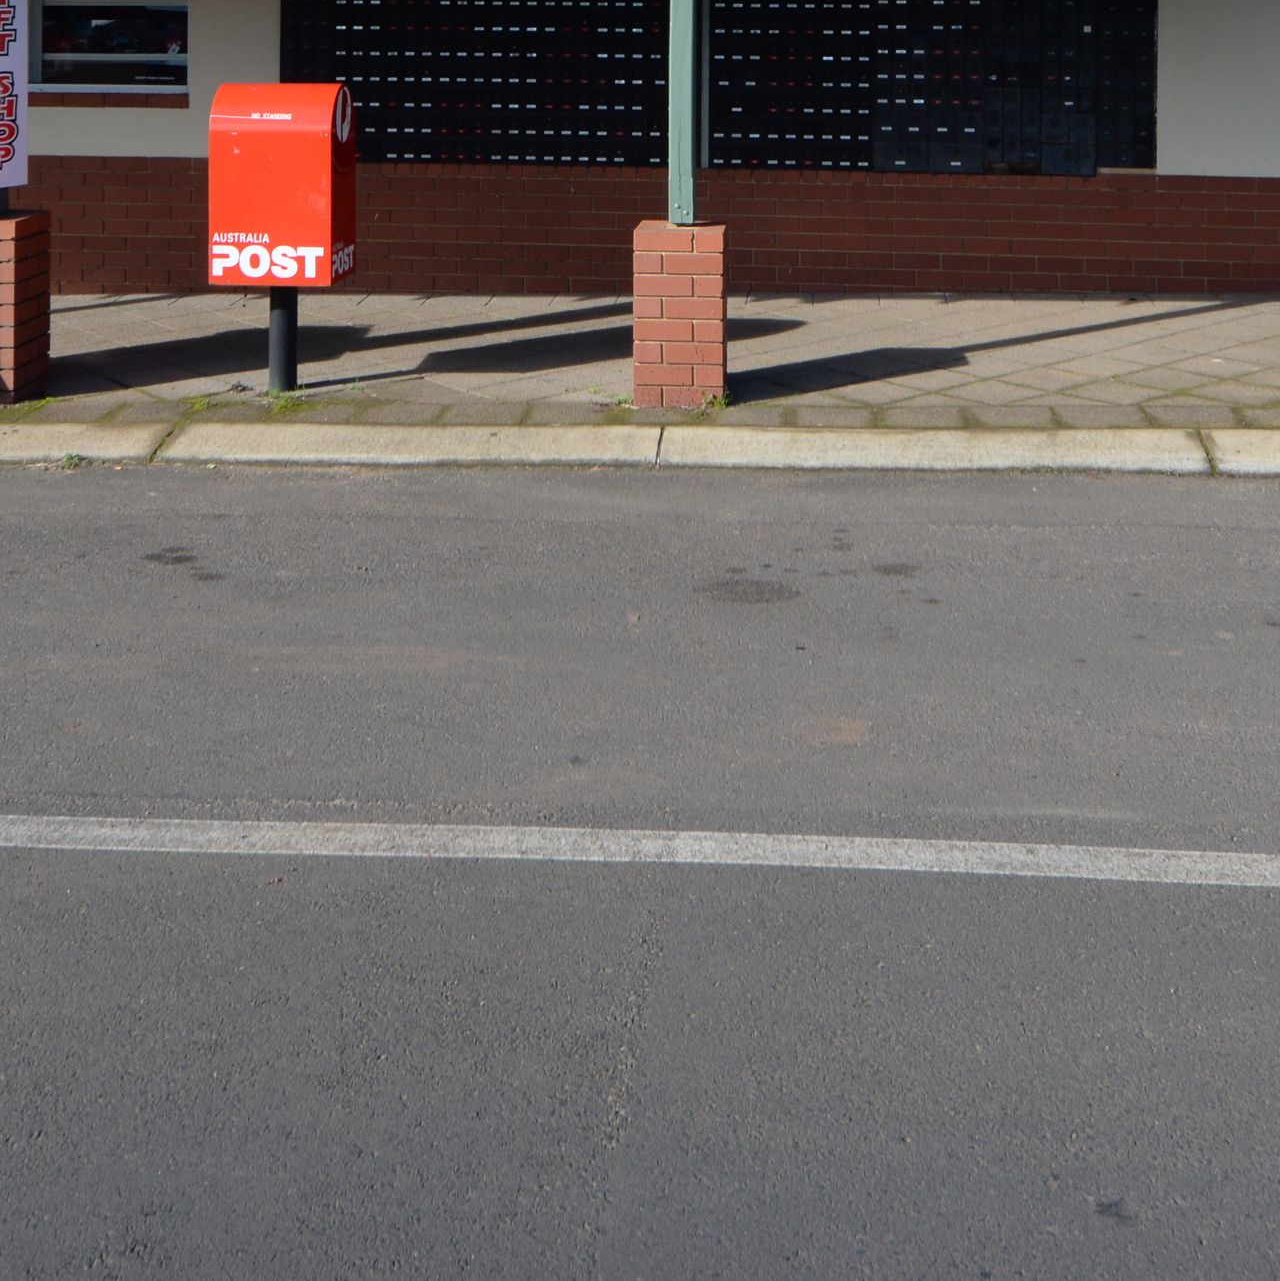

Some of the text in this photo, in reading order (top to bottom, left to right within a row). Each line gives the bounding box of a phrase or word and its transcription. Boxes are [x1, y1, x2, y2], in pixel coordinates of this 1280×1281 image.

[212, 232, 269, 243] AUSTRALIA
[212, 245, 324, 278] POST
[332, 244, 355, 279] POST
